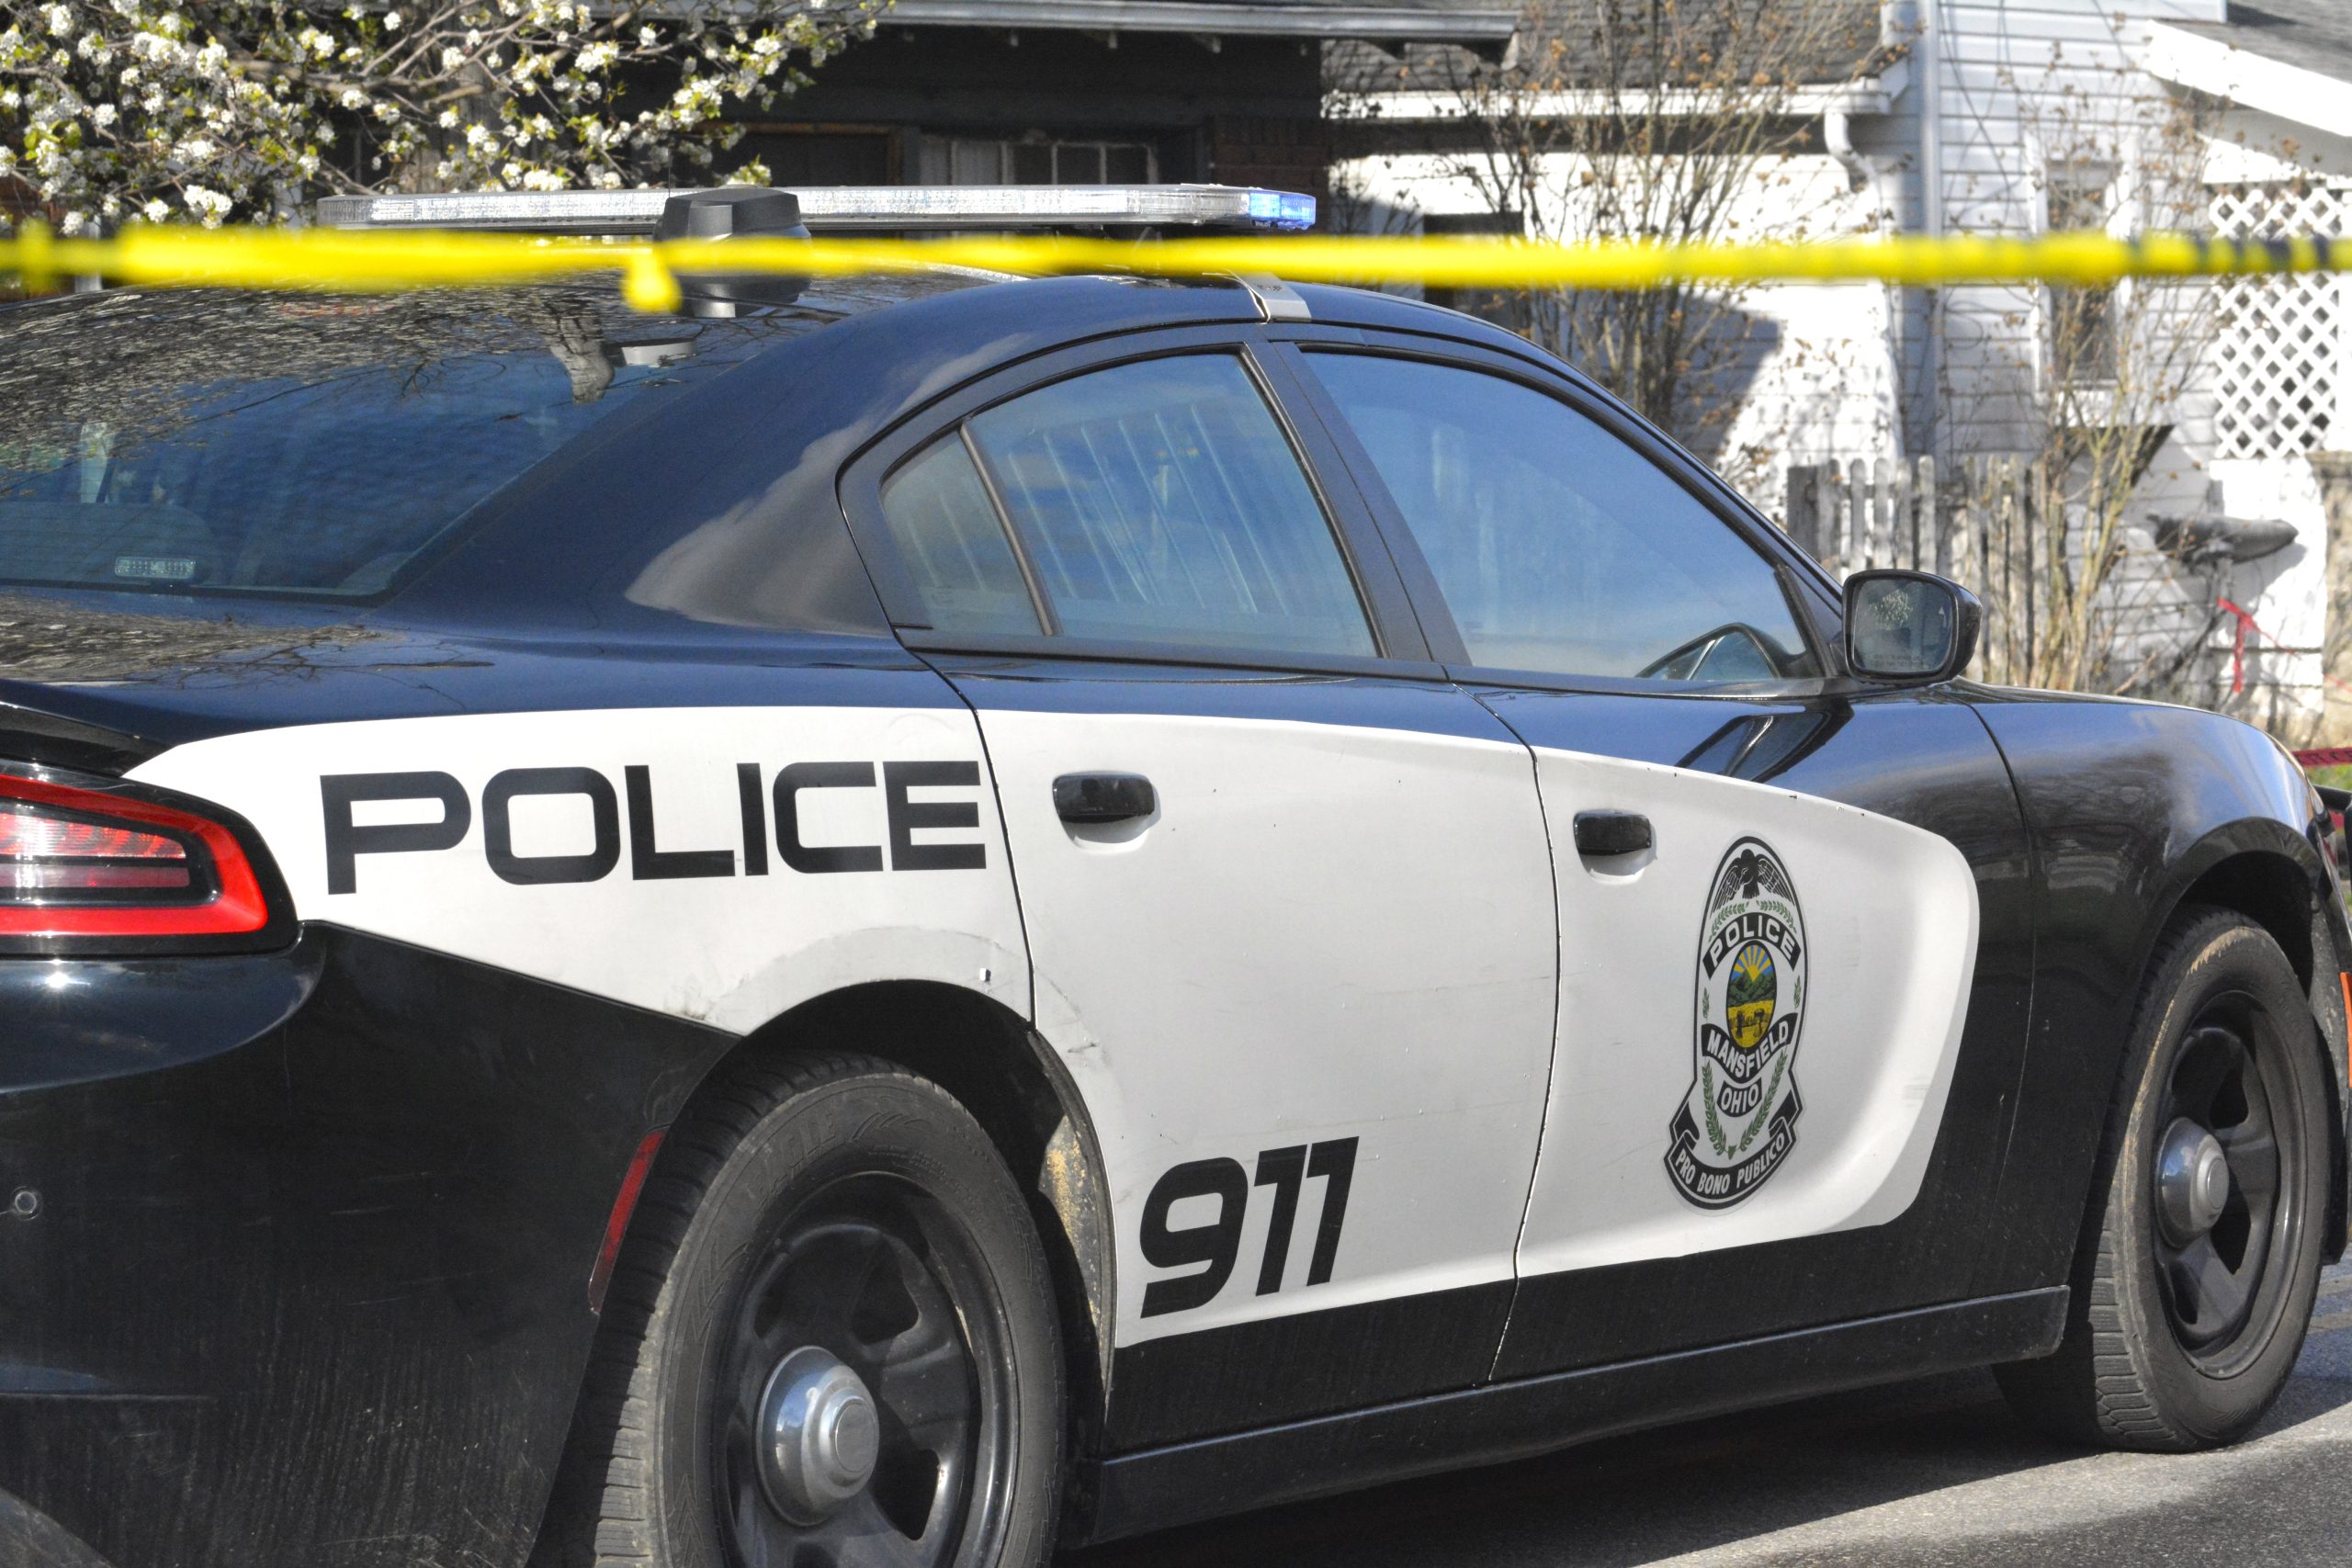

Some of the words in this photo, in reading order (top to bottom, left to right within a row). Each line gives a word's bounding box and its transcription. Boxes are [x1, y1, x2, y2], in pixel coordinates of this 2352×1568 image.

[320, 761, 987, 895] POLICE
[1710, 915, 1795, 968] POLICE
[1707, 1021, 1789, 1077] MANSFIELD
[1721, 1084, 1759, 1113] OHIO
[1676, 1148, 1696, 1184] PRO
[1697, 1172, 1731, 1194] BONO
[1736, 1133, 1784, 1189] PUBLICO
[1140, 1136, 1359, 1319] 911
